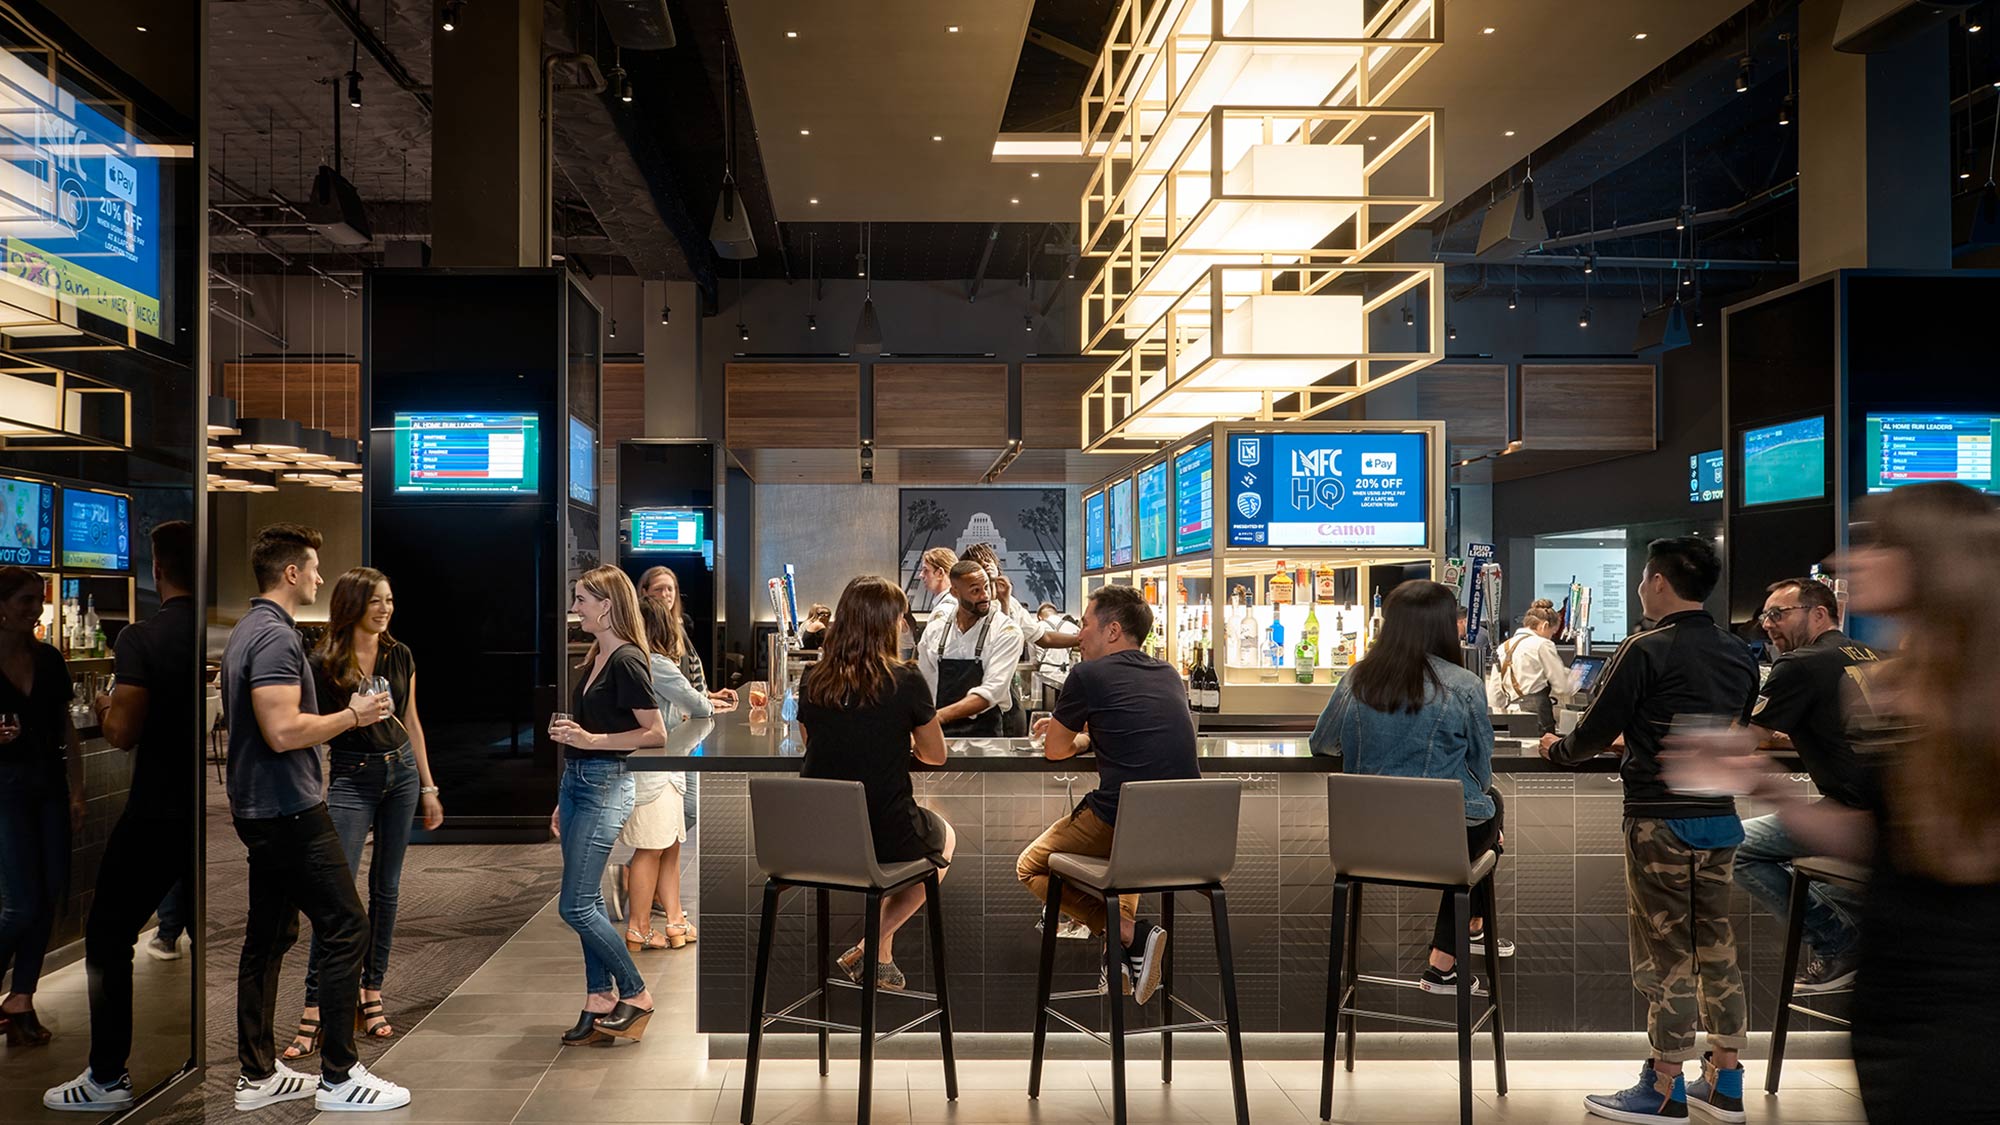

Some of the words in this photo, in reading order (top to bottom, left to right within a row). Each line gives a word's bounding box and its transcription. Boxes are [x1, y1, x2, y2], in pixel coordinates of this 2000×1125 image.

[117, 170, 134, 194] Pay
[99, 196, 121, 221] 20%
[123, 209, 143, 231] OFF
[1291, 448, 1343, 477] LAFC
[1374, 458, 1393, 470] Pay
[1291, 477, 1345, 511] HQ
[1355, 478, 1379, 489] 20%
[1381, 478, 1403, 489] OFF
[1317, 523, 1376, 536] Canon
[1471, 591, 1481, 630] ANGELES
[1838, 646, 1881, 662] VELA
